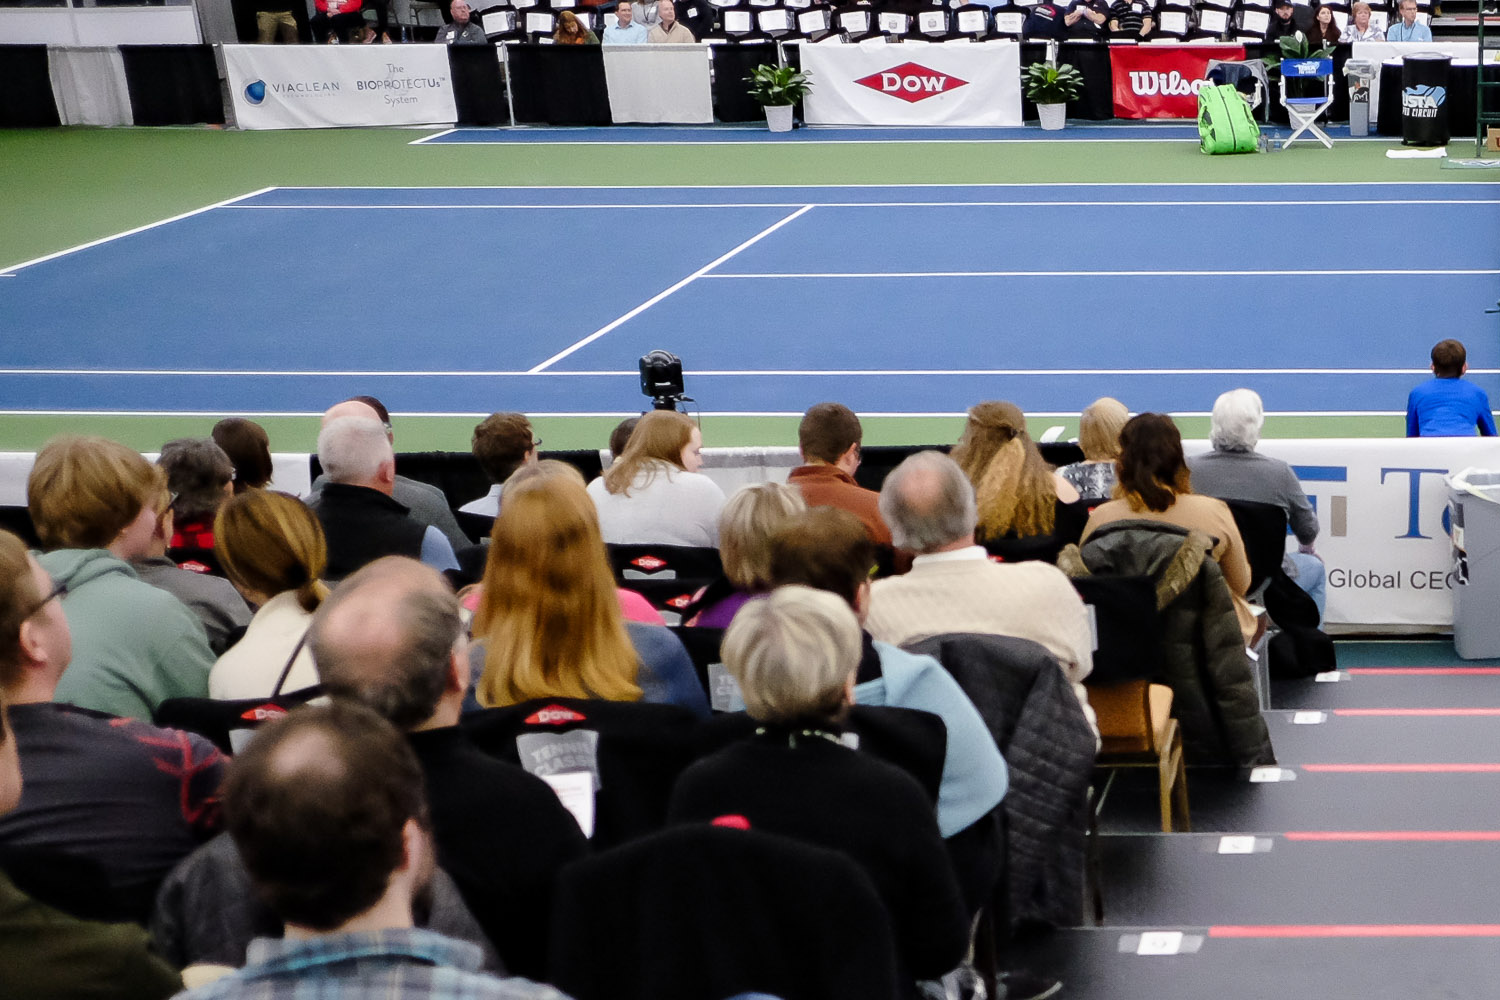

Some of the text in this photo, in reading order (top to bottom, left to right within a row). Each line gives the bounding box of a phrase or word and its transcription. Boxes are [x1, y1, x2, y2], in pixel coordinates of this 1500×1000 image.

[386, 63, 404, 73] The
[272, 82, 340, 93] VIACLEAN
[881, 72, 947, 92] DOW
[384, 95, 418, 107] System
[1328, 568, 1401, 589] Global
